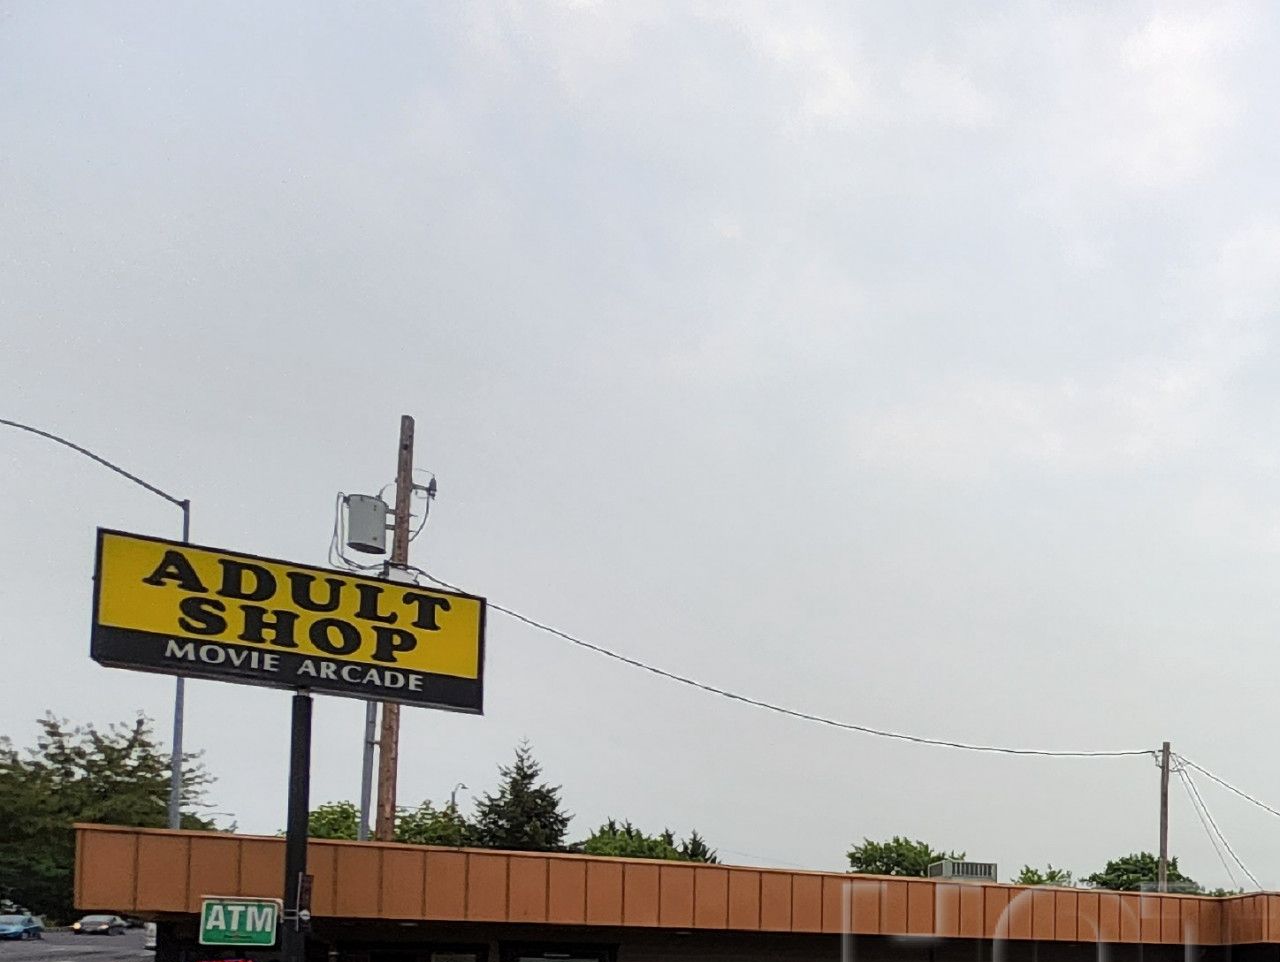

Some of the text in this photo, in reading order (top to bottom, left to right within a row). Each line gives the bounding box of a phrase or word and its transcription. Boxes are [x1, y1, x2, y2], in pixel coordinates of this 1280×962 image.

[143, 550, 451, 631] ADULT
[178, 596, 418, 662] SHOP
[165, 640, 424, 692] MOVIE ARCADE
[206, 905, 273, 932] ATM
